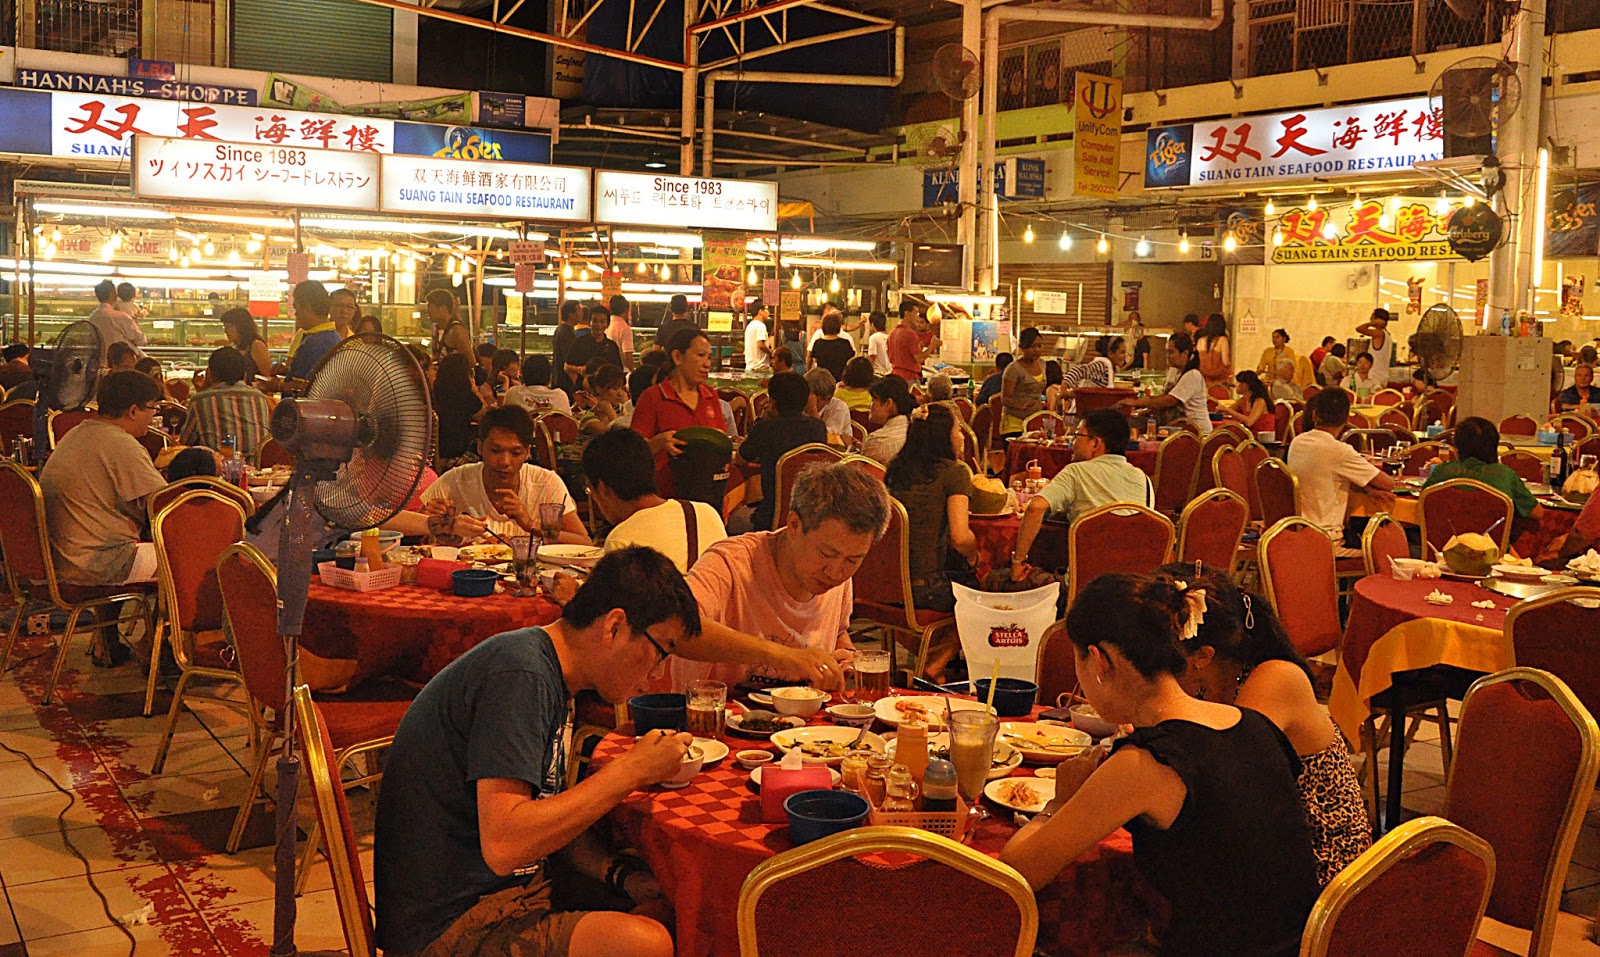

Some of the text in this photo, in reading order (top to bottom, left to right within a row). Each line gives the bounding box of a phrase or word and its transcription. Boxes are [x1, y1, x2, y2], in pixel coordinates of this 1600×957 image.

[20, 70, 249, 105] HANNAH'S SHOPPE
[1078, 121, 1118, 136] UnifyCom
[216, 145, 307, 166] Since 1983
[1081, 139, 1115, 152] Computer
[1150, 139, 1186, 168] Tiger
[1083, 165, 1110, 178] Service
[1199, 152, 1443, 181] SUANG TAIN SEAFOOD RESTAURAN
[654, 177, 722, 196] Since 1983
[399, 188, 575, 211] SUANG TAIN SEAFOOD RESTAURANT
[1276, 248, 1318, 259] SUANG
[1322, 247, 1349, 258] TAIN
[1353, 246, 1416, 257] SEAFOOD
